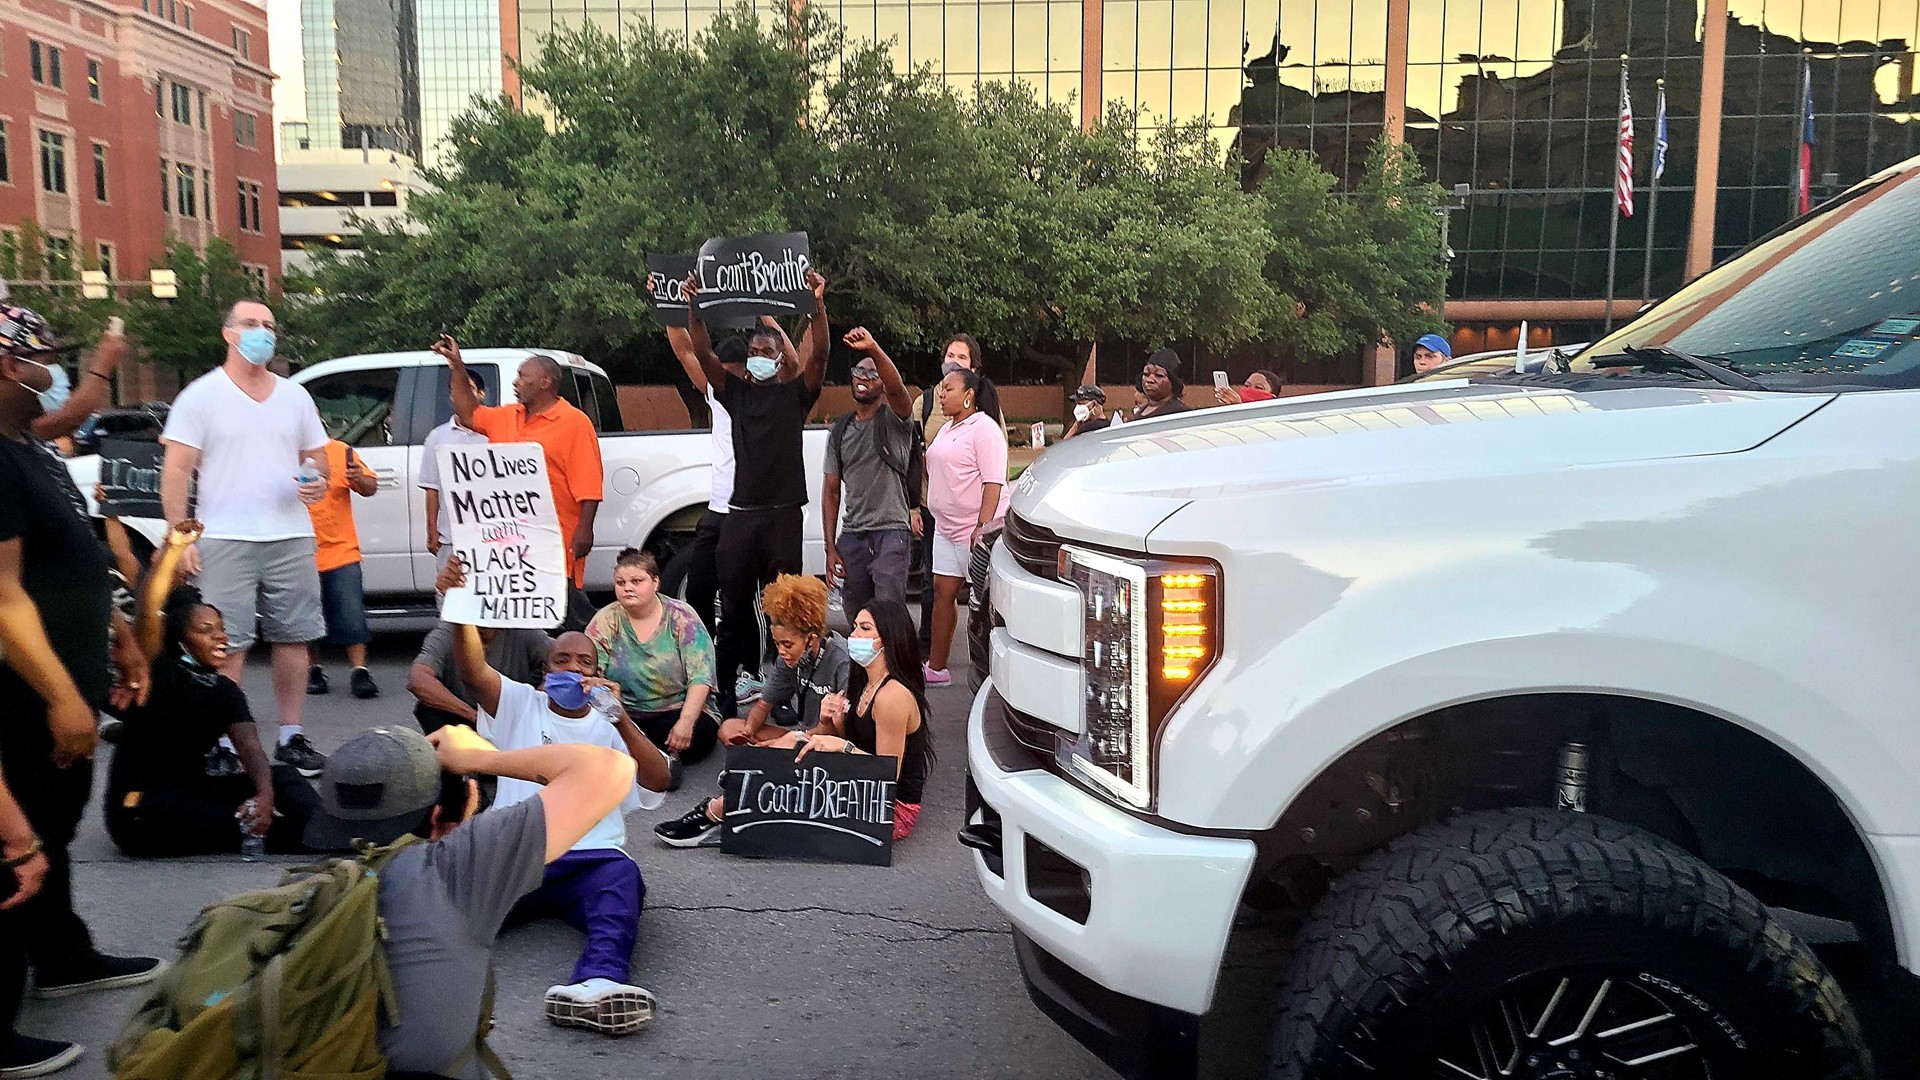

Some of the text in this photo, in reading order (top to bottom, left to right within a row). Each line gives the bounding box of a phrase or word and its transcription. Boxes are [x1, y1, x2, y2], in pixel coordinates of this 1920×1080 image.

[651, 271, 668, 301] I
[698, 248, 810, 296] I can't Breathe
[450, 448, 538, 483] No Lives
[450, 489, 540, 525] Matter
[481, 519, 520, 542] until
[455, 544, 536, 575] BLACK
[473, 570, 537, 596] LIVES
[480, 596, 560, 622] MATTER
[725, 766, 897, 825] I can't BREATHE
